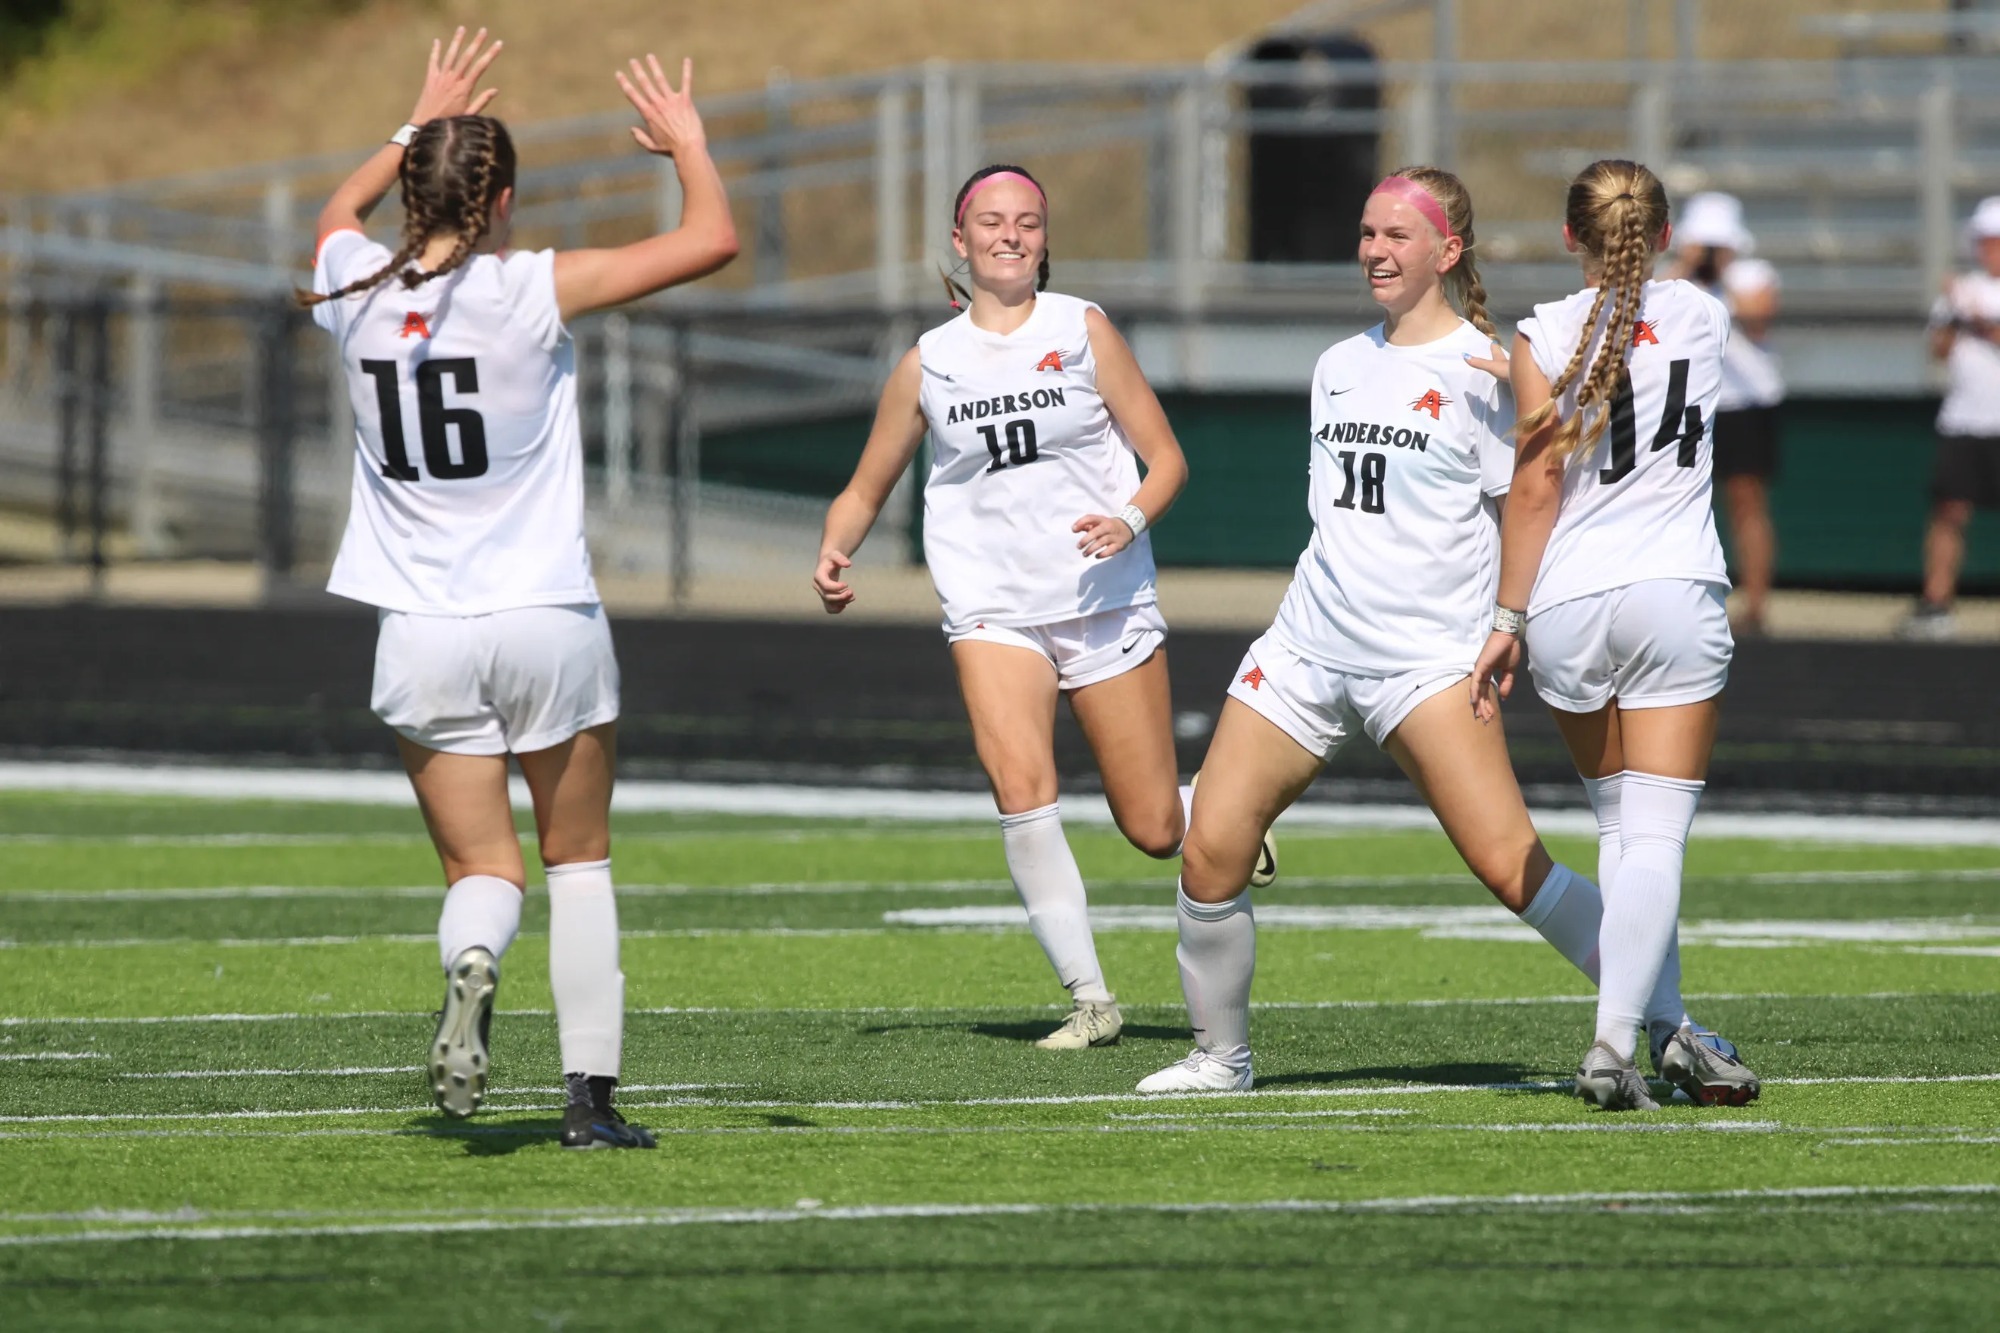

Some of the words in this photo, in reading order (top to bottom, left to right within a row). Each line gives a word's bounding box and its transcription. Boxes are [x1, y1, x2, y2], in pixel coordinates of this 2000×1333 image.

[360, 357, 489, 482] 16
[946, 387, 1067, 426] ANDERSON
[1599, 358, 1705, 486] 14
[976, 418, 1039, 474] 10
[1315, 422, 1431, 453] ANDERSON
[1333, 450, 1387, 515] 18
